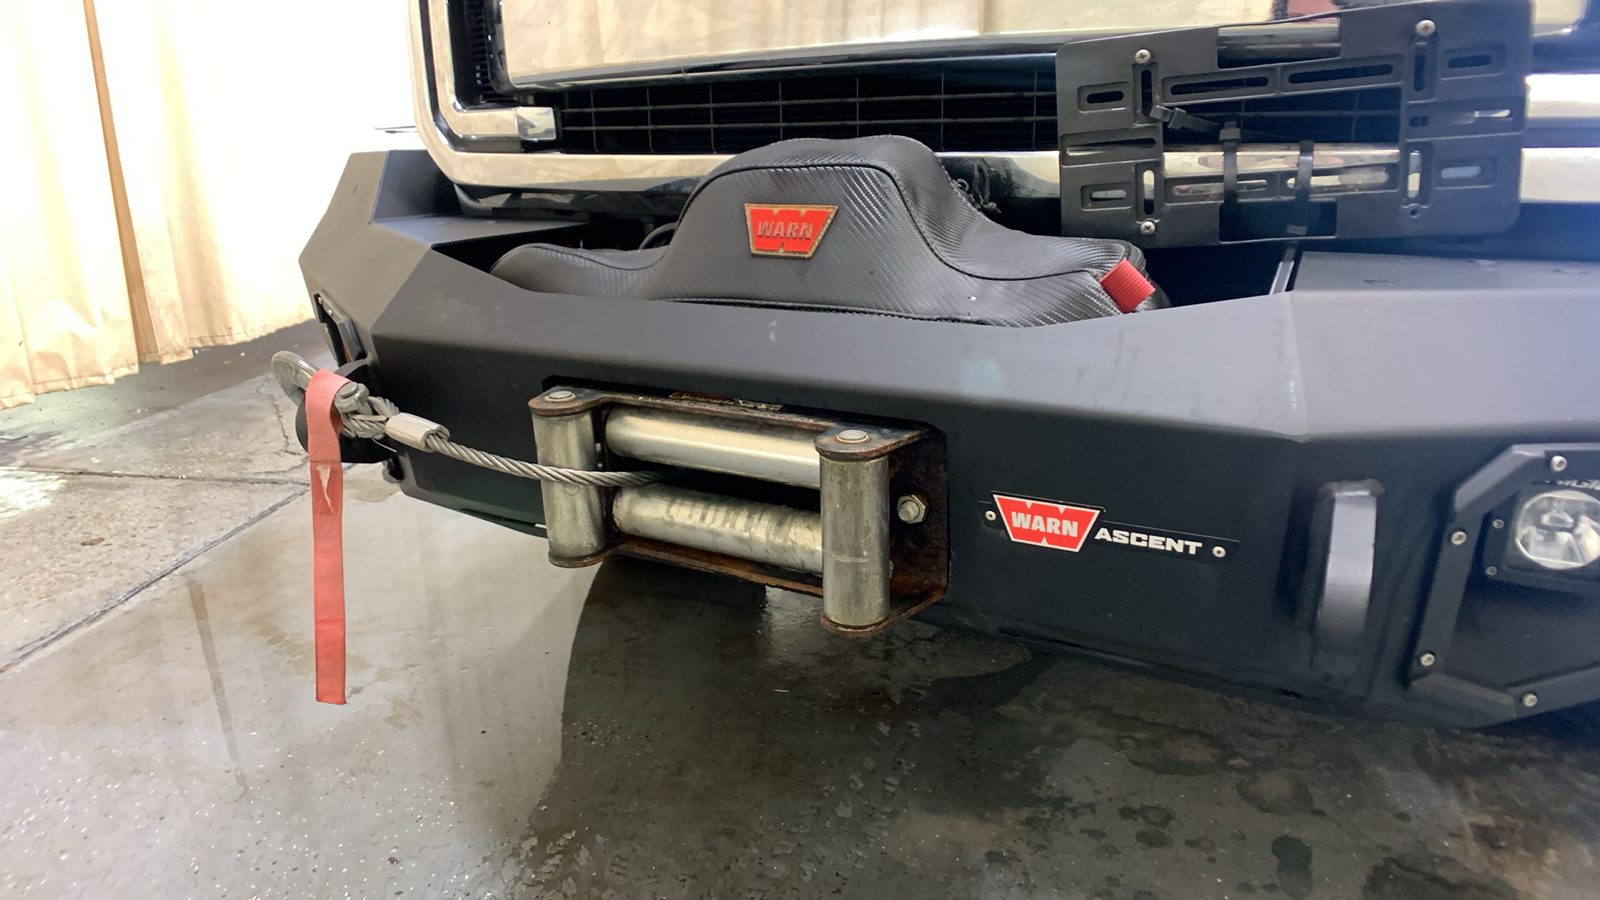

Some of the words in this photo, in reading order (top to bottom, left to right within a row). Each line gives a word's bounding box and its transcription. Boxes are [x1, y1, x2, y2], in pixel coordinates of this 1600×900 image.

[757, 220, 814, 240] WARN
[1011, 511, 1078, 538] WARN
[1094, 527, 1202, 555] ASCENT
